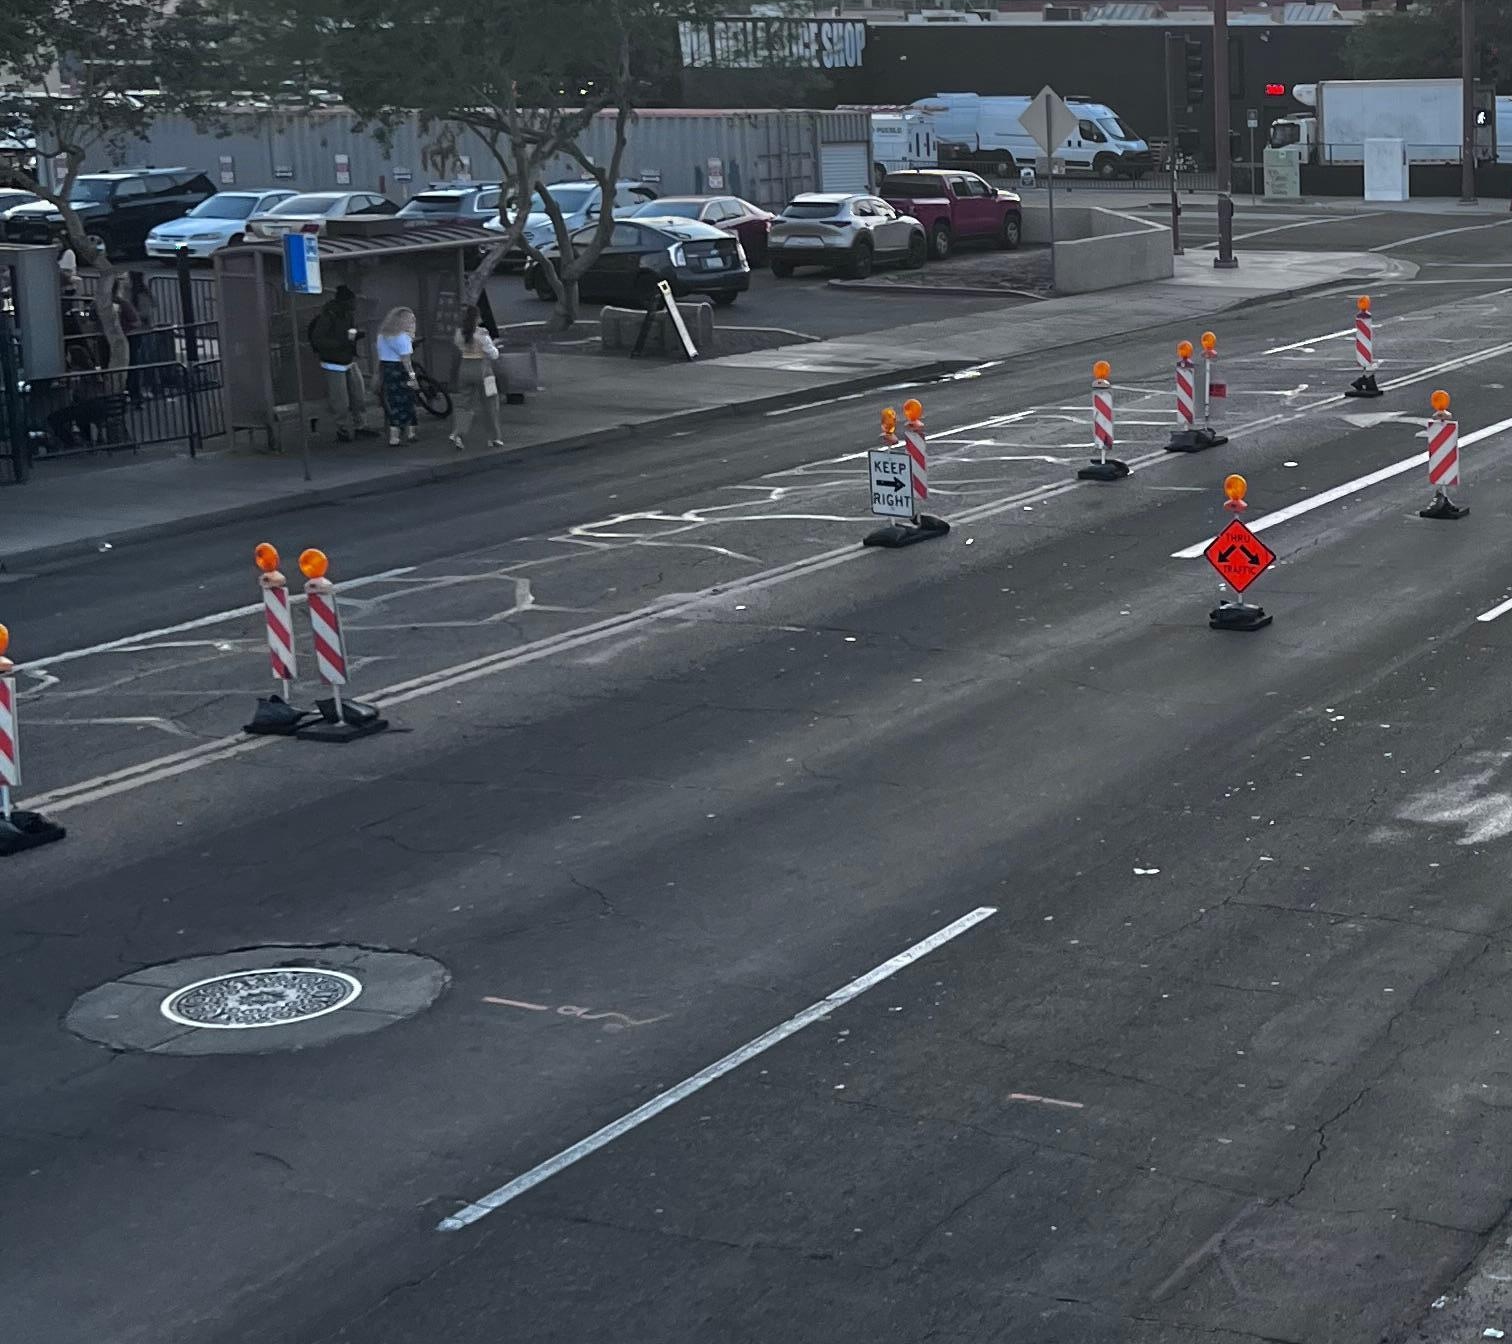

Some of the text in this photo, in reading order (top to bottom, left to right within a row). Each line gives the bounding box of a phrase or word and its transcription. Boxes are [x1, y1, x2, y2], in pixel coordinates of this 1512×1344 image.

[821, 22, 866, 68] SHOP
[873, 460, 907, 475] KEEP
[873, 492, 911, 507] RIGHT
[1225, 533, 1251, 544] THRU
[1223, 564, 1257, 575] TRAFFIC
